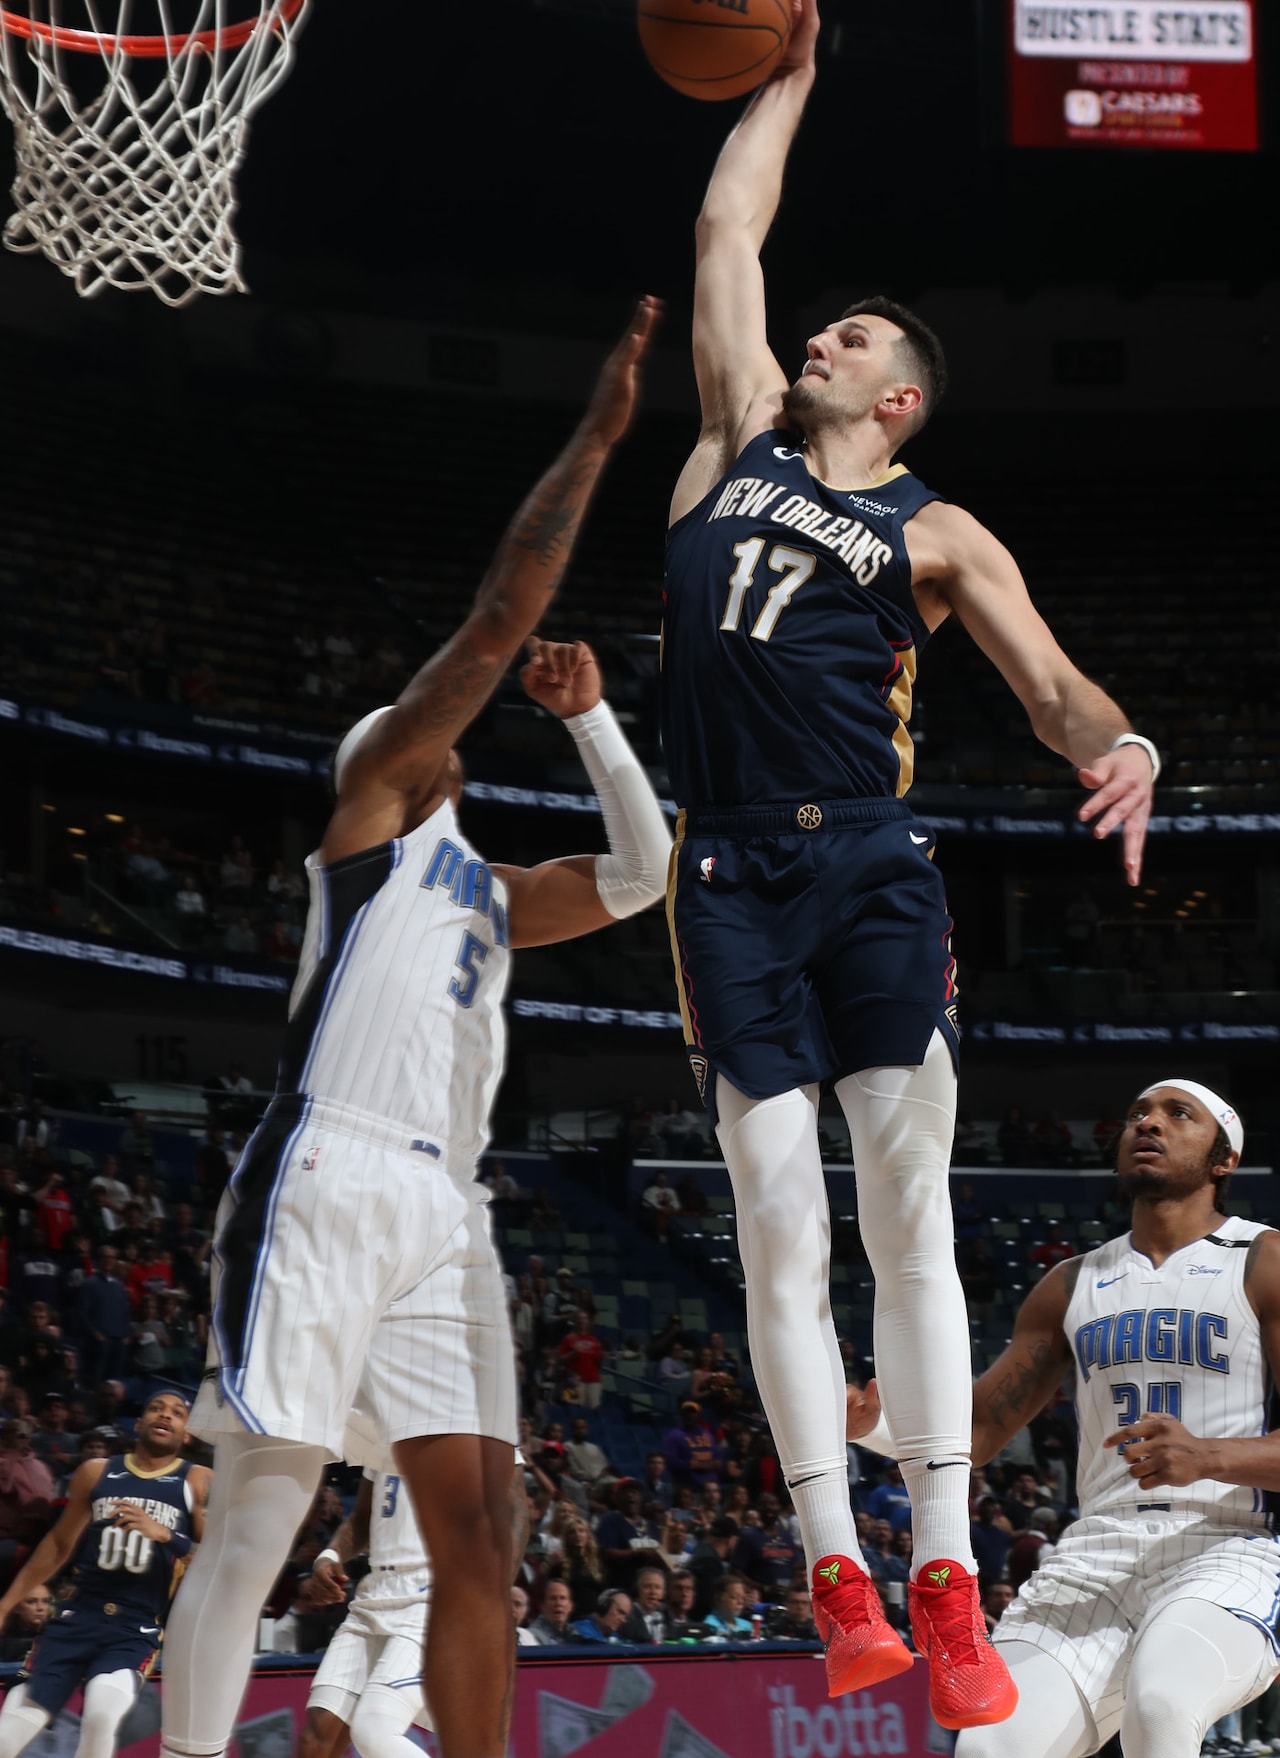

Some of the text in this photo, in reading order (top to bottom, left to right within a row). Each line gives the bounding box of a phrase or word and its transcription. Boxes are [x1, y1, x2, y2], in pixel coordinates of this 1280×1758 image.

[1025, 8, 1241, 46] HUSTLE STATS
[1101, 90, 1203, 115] CAESARS
[848, 494, 899, 514] NEWAGE
[853, 502, 886, 517] GARAGE
[707, 477, 893, 587] NEW ORLEANS
[719, 537, 817, 642] 17
[540, 789, 601, 812] ORLE
[1173, 814, 1213, 833] OF
[0, 925, 188, 979] RLEANS PELICANS
[447, 929, 488, 1009] 5
[513, 999, 583, 1022] SPIRIT
[584, 1006, 620, 1025] OF
[620, 1008, 668, 1029] THE
[1185, 1264, 1223, 1277] Disney
[1075, 1308, 1230, 1384] MAGIC
[381, 1474, 400, 1518] 3
[98, 1525, 152, 1573] 00
[767, 1684, 908, 1758] ibotta
